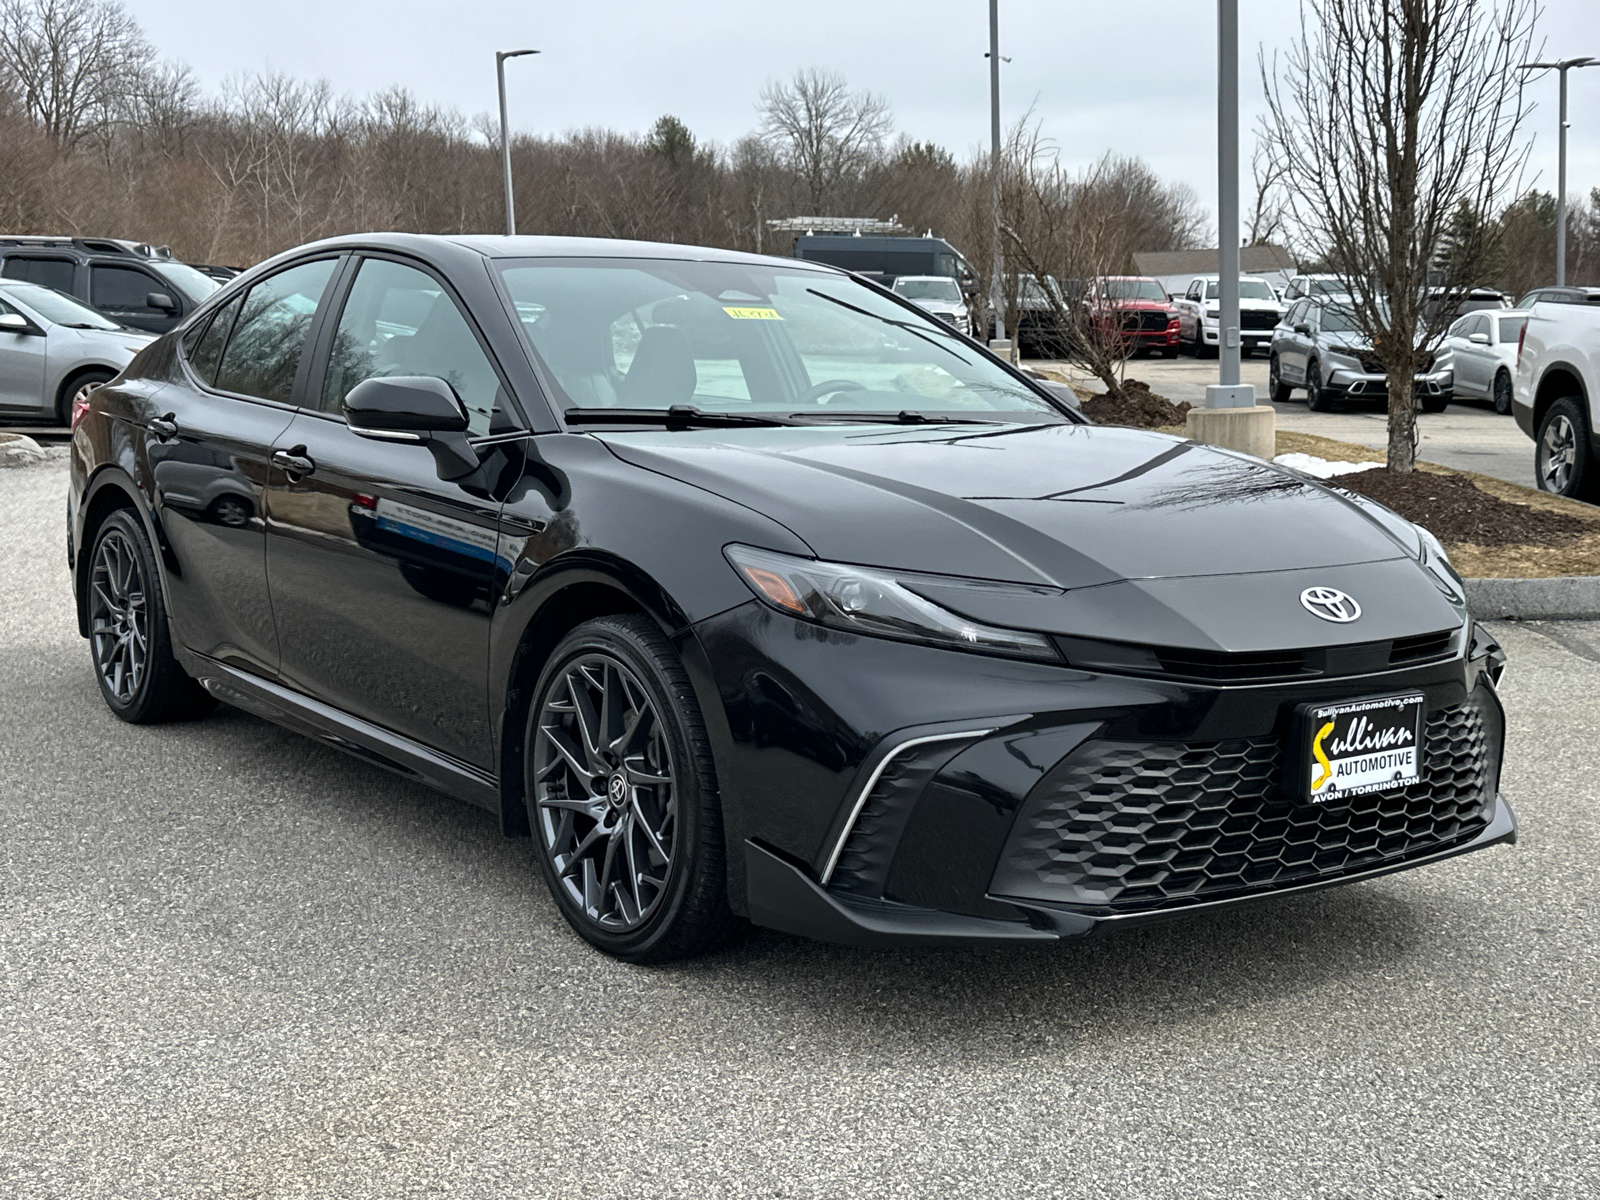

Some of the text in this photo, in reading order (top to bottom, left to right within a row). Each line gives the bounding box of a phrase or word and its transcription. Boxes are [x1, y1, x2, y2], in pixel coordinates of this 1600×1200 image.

[1317, 696, 1423, 718] SullivanAutomotive.com
[1312, 716, 1413, 790] Sullivan
[1336, 751, 1412, 777] AUTOMOTIVE
[1312, 790, 1342, 803] AVON
[1351, 776, 1420, 796] TORRINGTON
